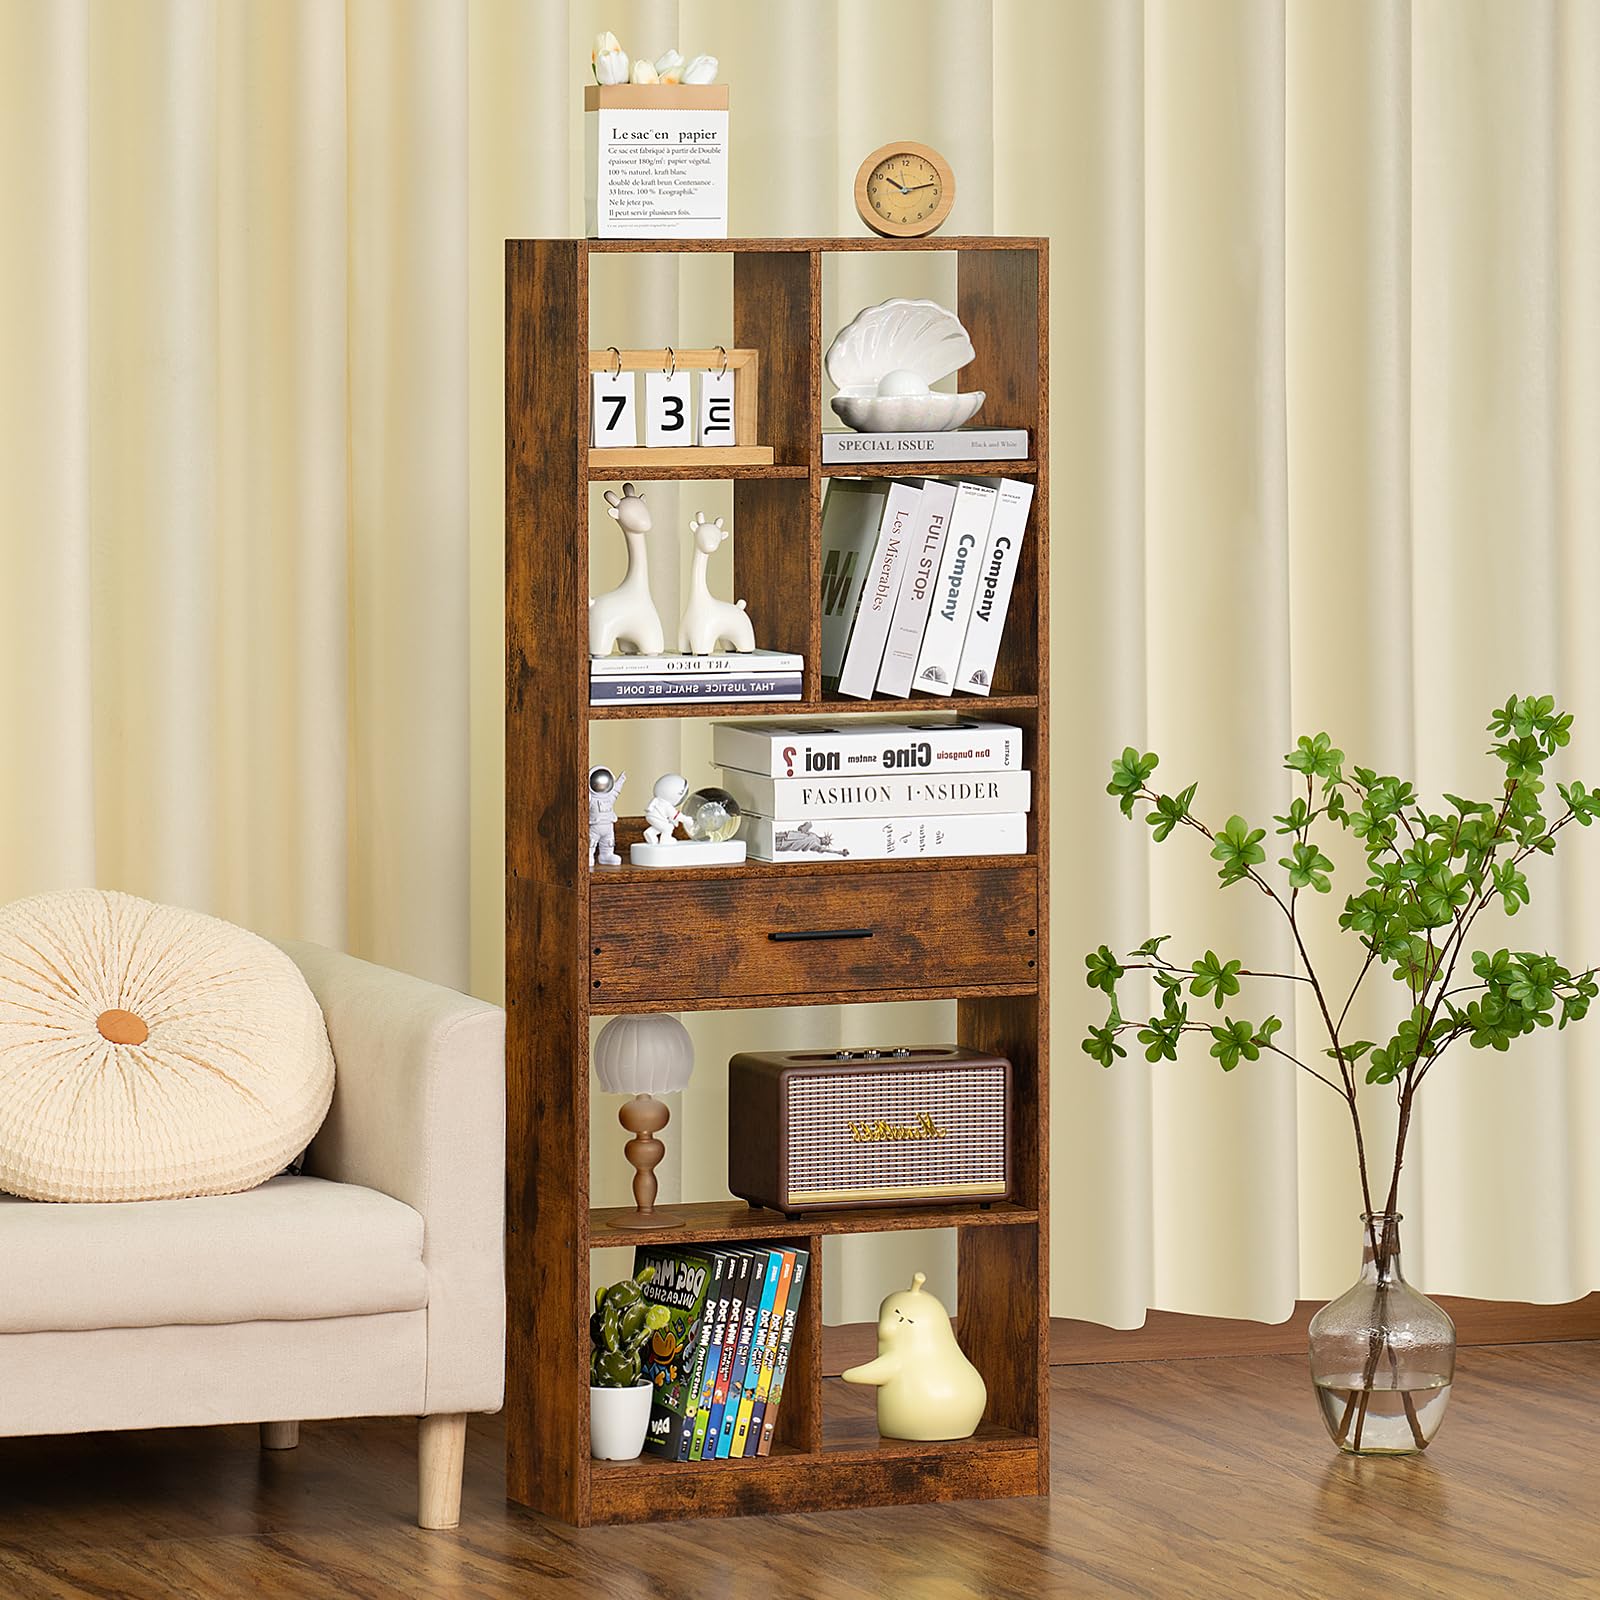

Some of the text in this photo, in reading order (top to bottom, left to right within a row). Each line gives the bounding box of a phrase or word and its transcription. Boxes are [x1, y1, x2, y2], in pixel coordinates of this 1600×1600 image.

[612, 128, 628, 140] Le
[654, 132, 668, 140] en
[678, 129, 717, 143] papier
[602, 396, 626, 430] 7
[661, 396, 684, 431] 3
[838, 440, 934, 451] SPECIAL ISSUE
[872, 511, 908, 611] Les Miserables
[911, 514, 944, 600] FULL STOP.
[941, 534, 975, 622] Company
[976, 536, 1011, 622] Company
[802, 786, 891, 804] FASHION
